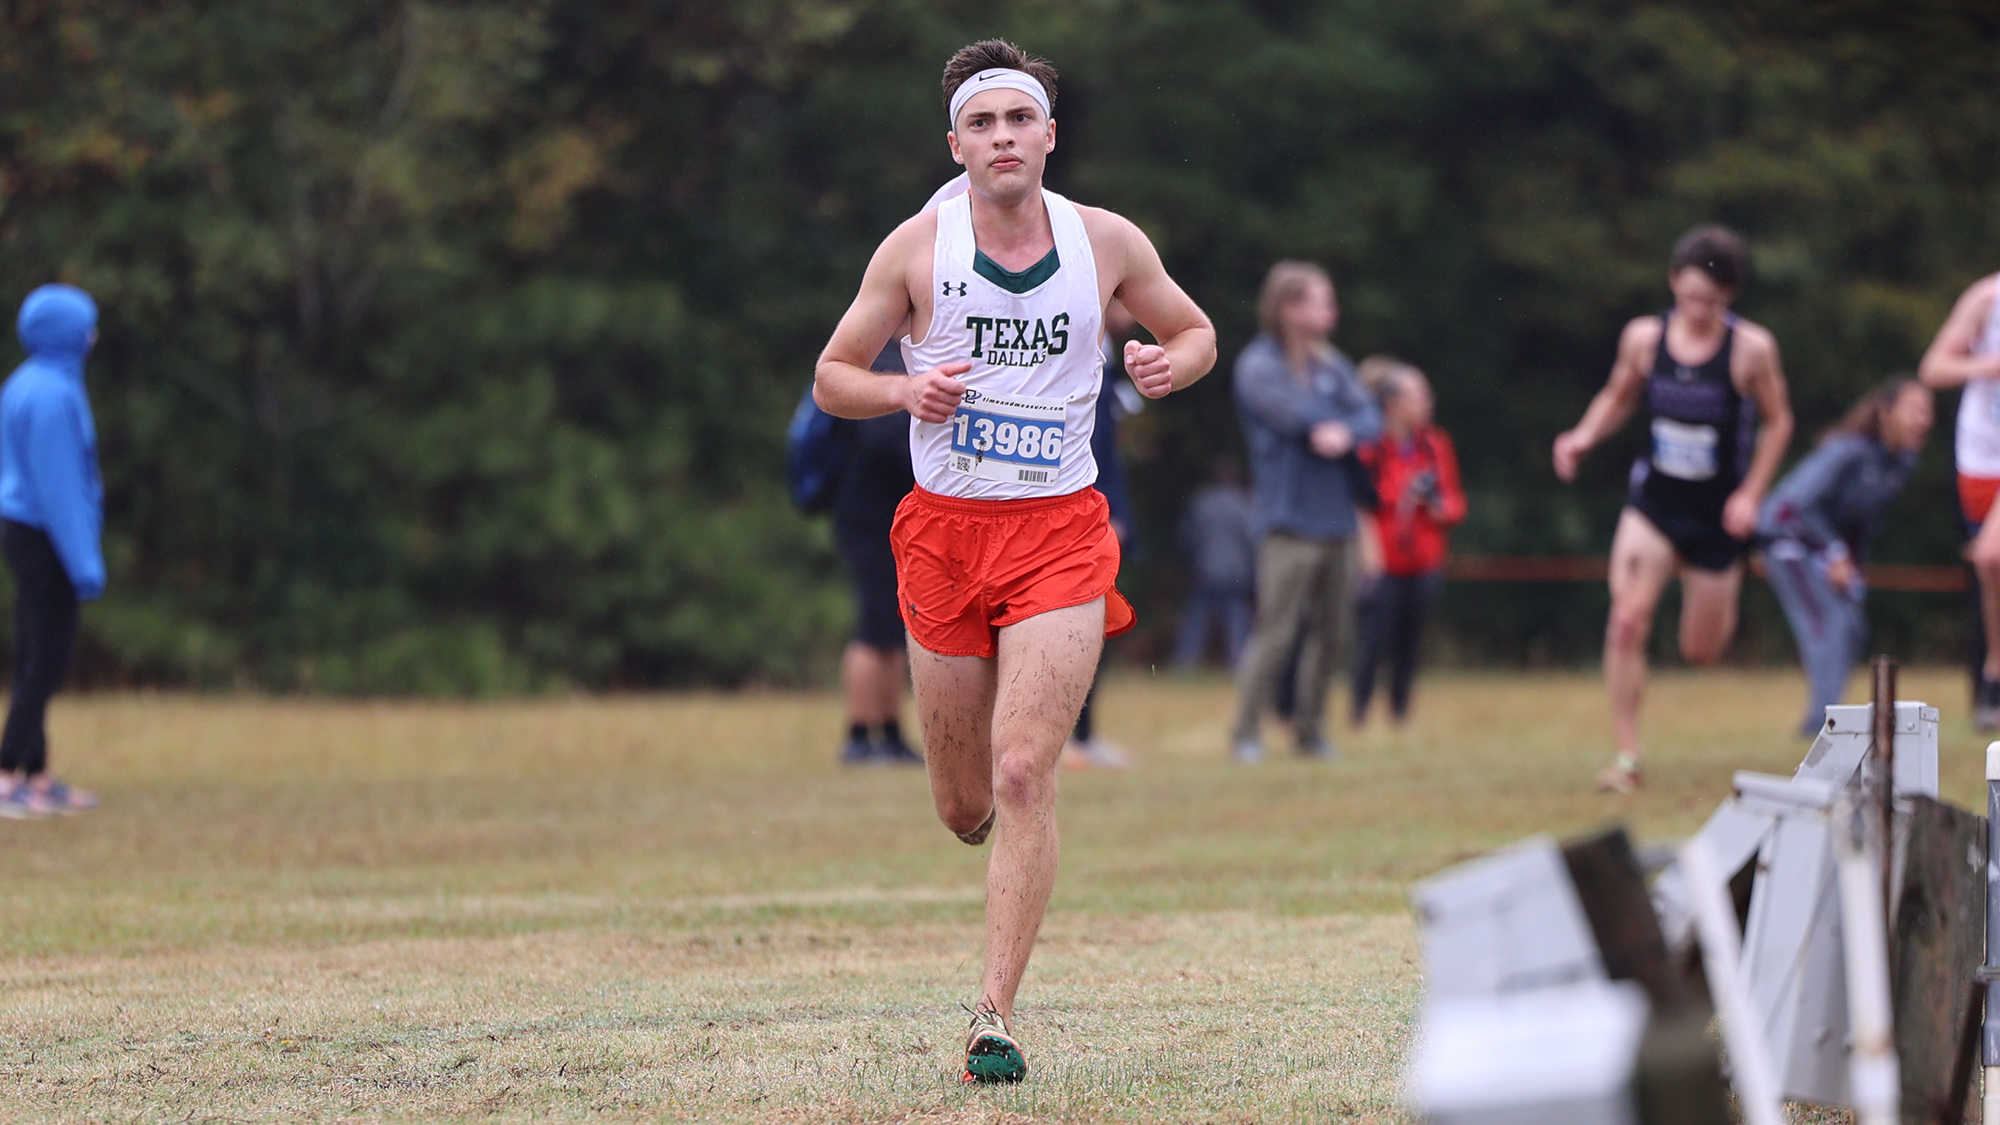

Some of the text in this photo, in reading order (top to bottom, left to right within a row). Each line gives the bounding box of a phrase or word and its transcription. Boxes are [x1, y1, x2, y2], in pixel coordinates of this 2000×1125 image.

[966, 312, 1070, 358] TEXAS
[987, 350, 1046, 367] DALLAS
[982, 397, 1064, 411] timeandmeasure.com
[954, 413, 1063, 460] 13986
